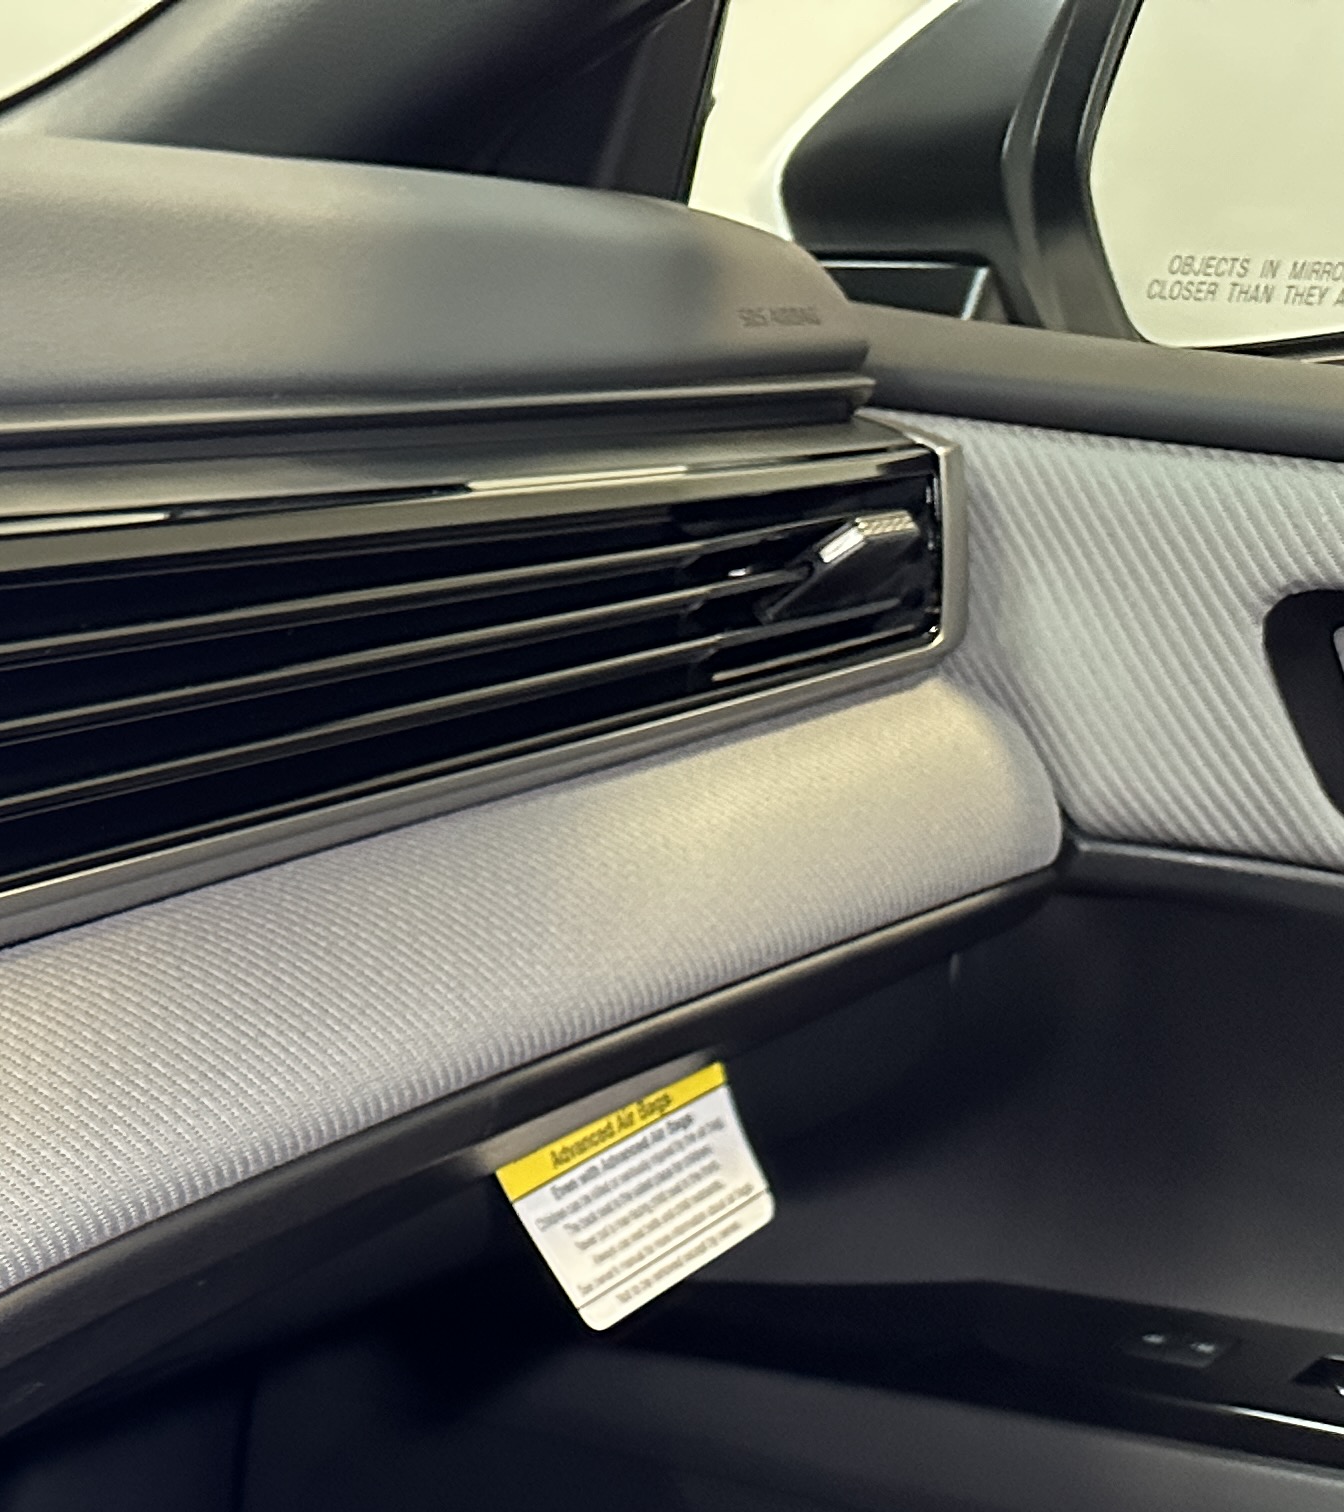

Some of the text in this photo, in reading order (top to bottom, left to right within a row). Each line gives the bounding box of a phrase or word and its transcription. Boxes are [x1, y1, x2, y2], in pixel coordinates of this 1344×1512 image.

[1167, 254, 1251, 279] OBJECTS
[1260, 259, 1282, 280] IN
[1146, 278, 1219, 302] CLOSER
[1227, 281, 1276, 305] THAN
[1283, 284, 1331, 307] THEY
[550, 1092, 673, 1169] Advanced Air Bags
